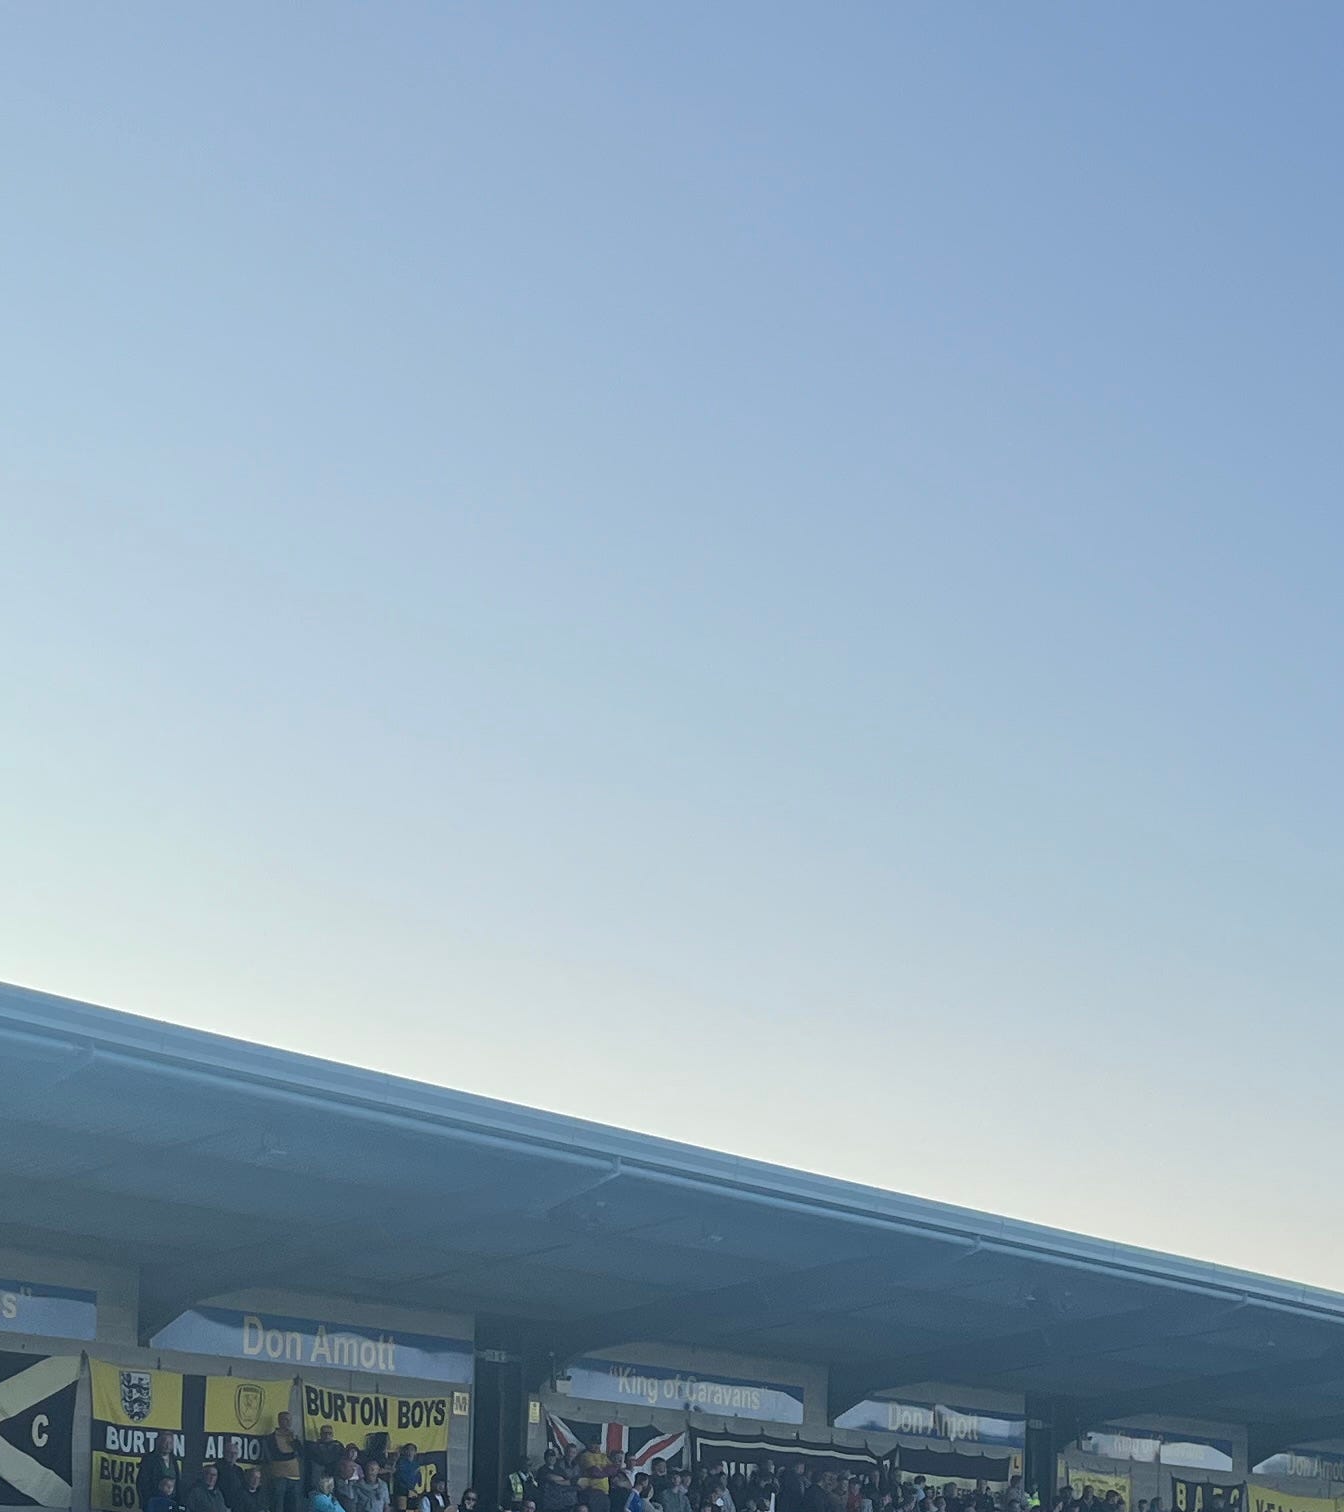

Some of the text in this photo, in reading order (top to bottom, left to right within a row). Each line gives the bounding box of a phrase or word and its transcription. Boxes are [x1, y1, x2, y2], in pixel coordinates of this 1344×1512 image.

[243, 1315, 302, 1361] Don
[664, 1375, 680, 1399] of
[305, 1386, 446, 1429] BURTON BOYS
[888, 1402, 923, 1434] Don
[31, 1414, 49, 1447] C
[107, 1426, 260, 1461] BURTN ALBIO
[112, 1485, 135, 1508] BO
